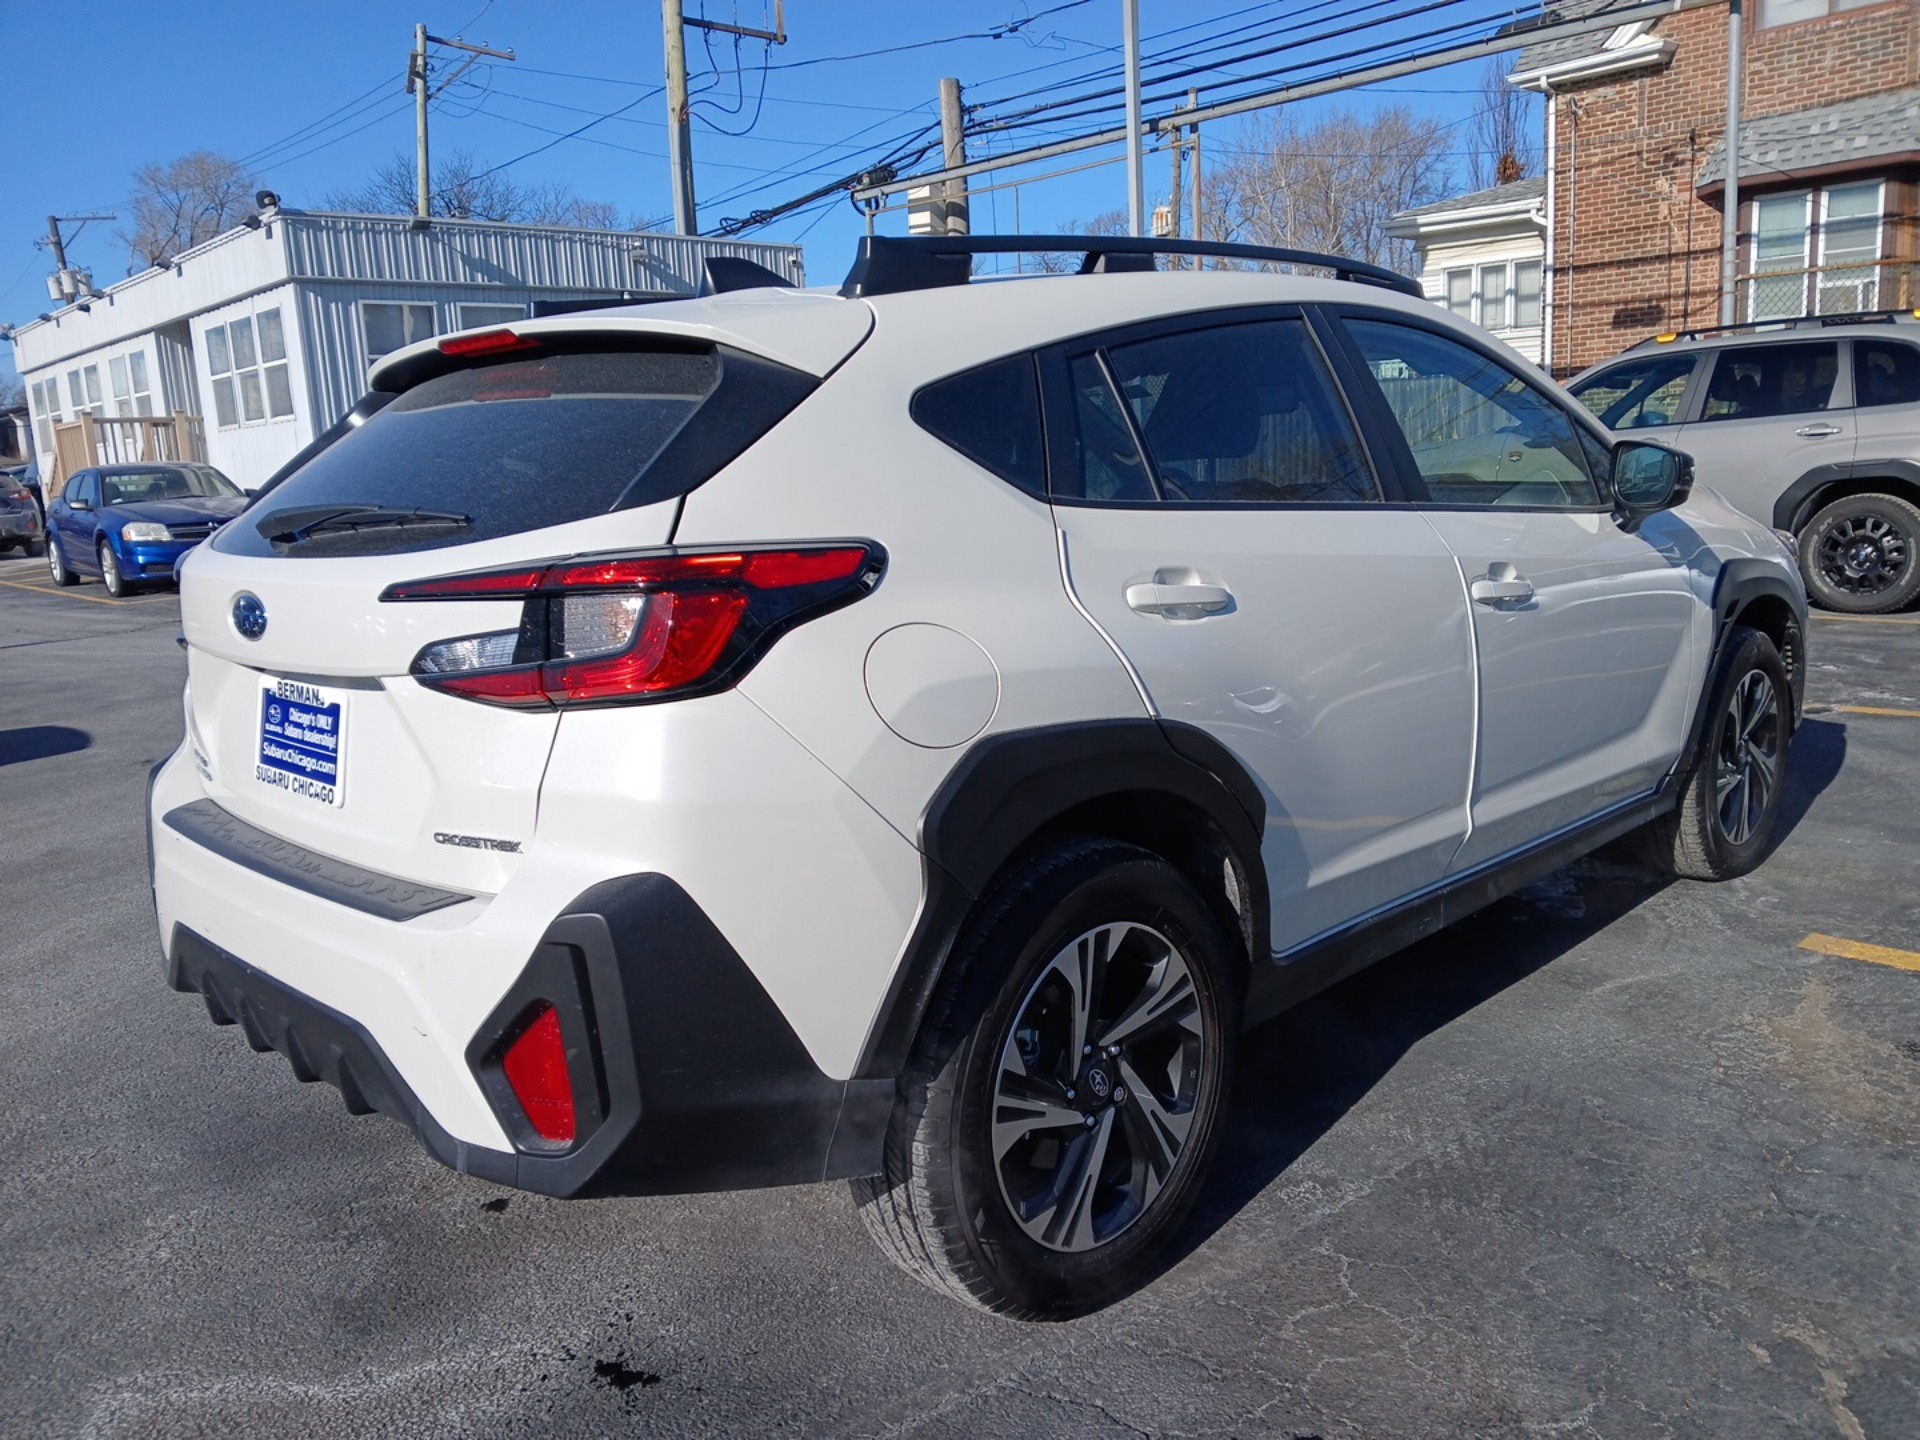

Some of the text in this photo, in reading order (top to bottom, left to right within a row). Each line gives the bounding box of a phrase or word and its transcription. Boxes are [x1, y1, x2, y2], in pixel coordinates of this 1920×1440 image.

[277, 681, 320, 705] BERMAN
[289, 707, 334, 730] Chicago's ONLY
[284, 722, 337, 751] Subaru dealership!
[263, 742, 336, 776] SubaruChicago.com
[255, 765, 335, 805] SUBARU CHICAGO
[433, 832, 524, 854] CROSSTREK
